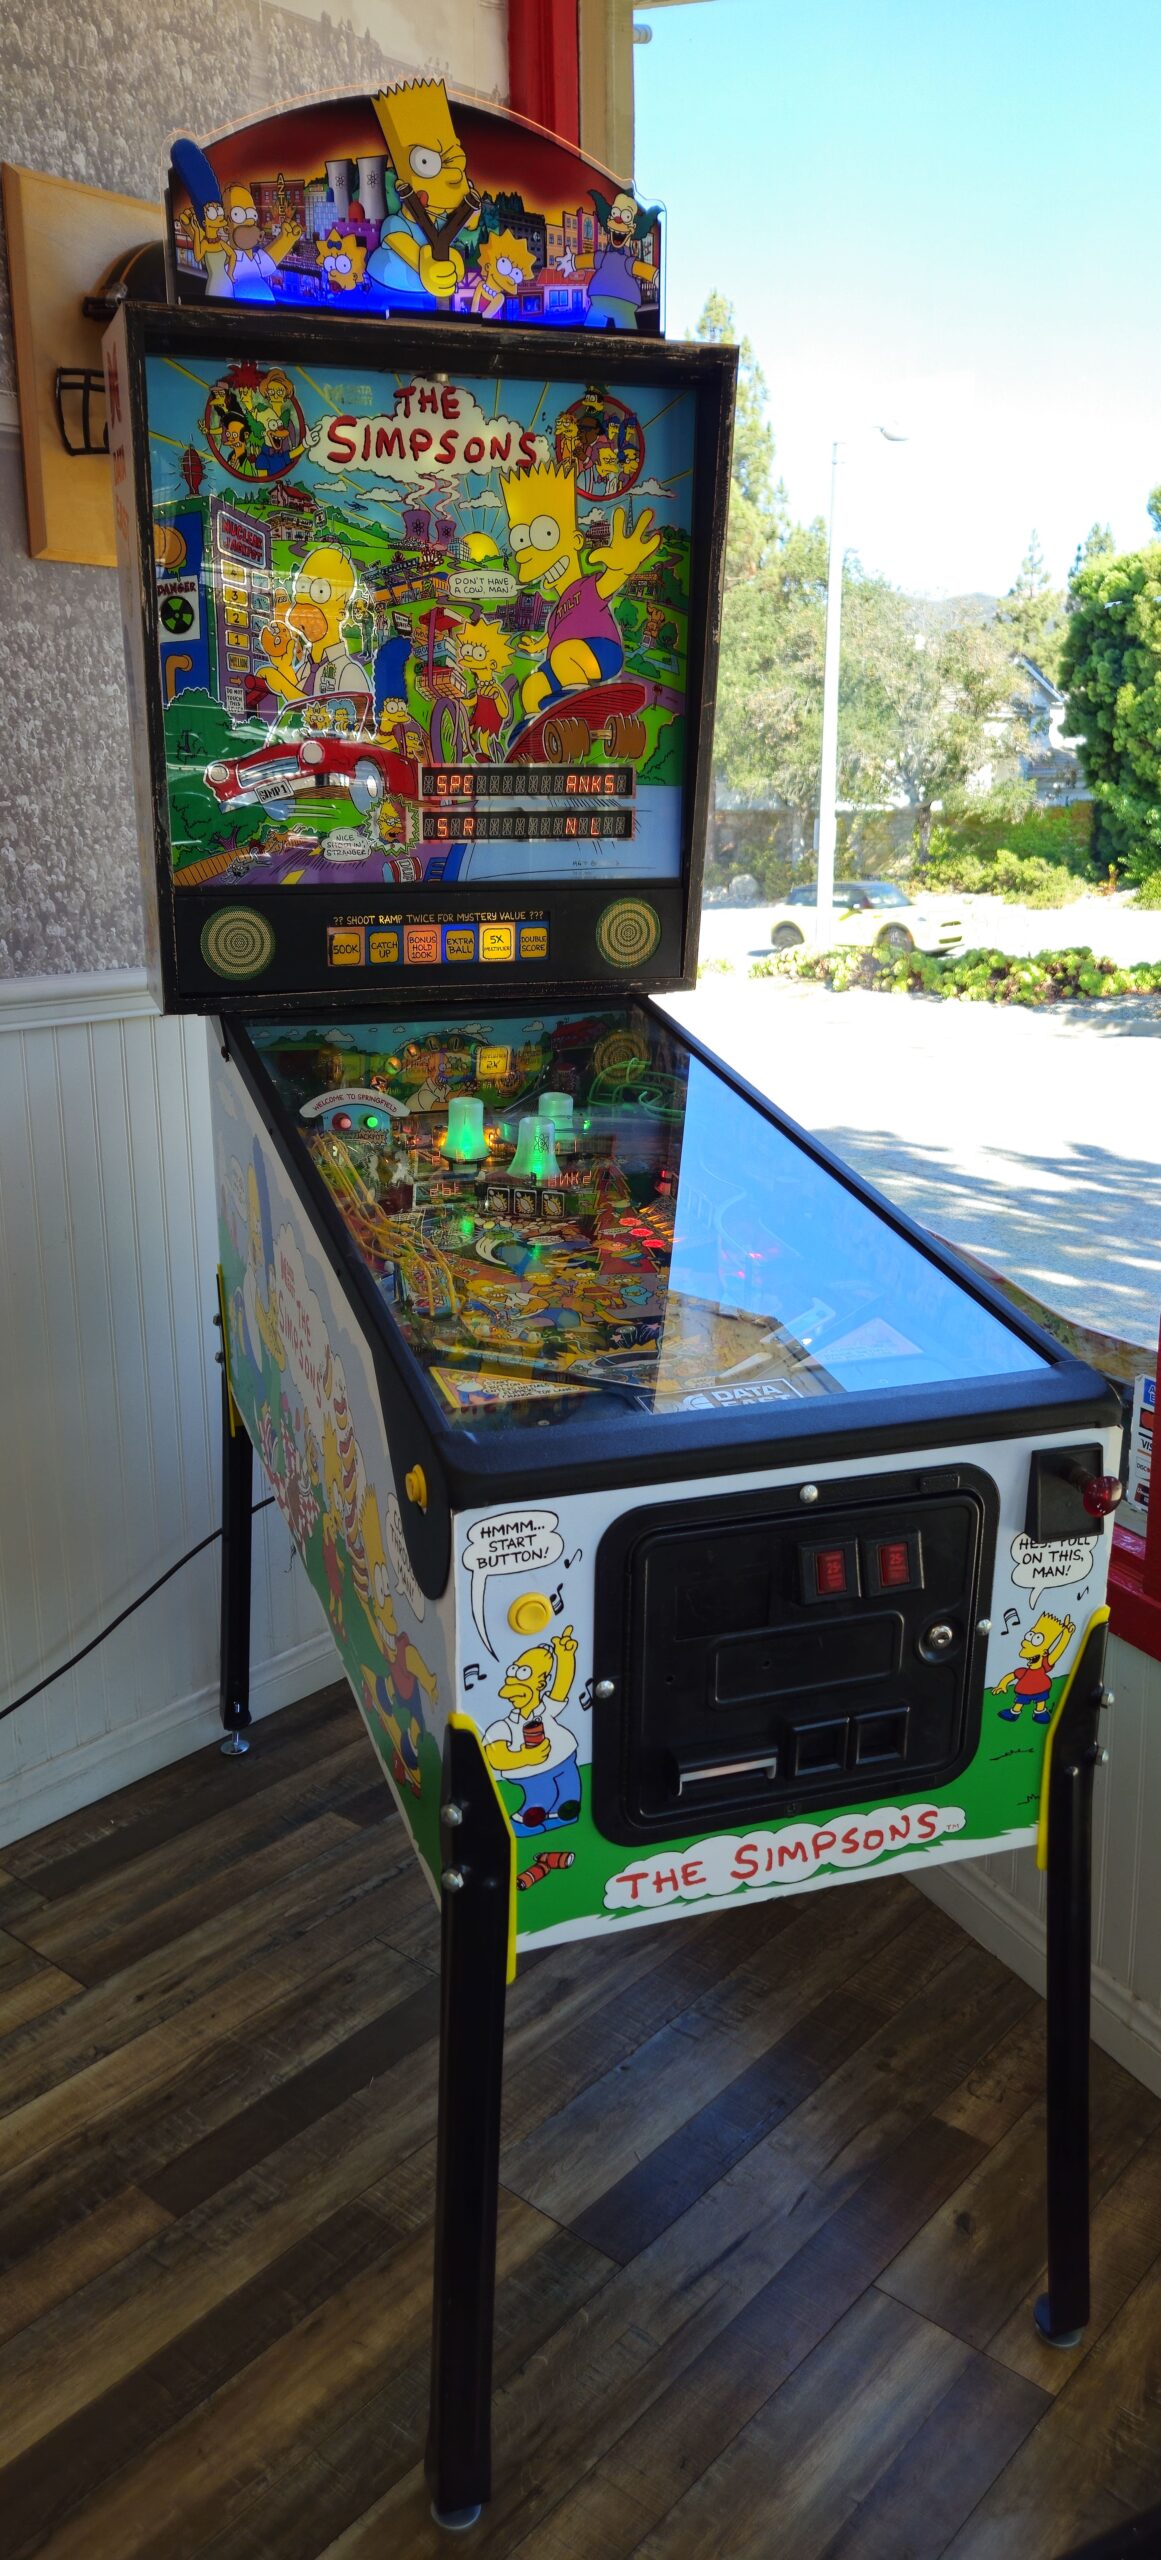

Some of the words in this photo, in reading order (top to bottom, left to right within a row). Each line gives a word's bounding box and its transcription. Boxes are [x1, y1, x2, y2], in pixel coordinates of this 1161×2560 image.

[393, 385, 461, 420] THE
[327, 415, 536, 468] SIMPSONS
[156, 581, 197, 596] DANGER
[488, 585, 514, 593] MAN!
[232, 591, 239, 600] 3
[556, 592, 581, 618] TILT
[232, 613, 240, 624] 2
[234, 635, 241, 645] 1
[437, 775, 474, 794] SPE
[566, 775, 615, 793] ANKS
[333, 916, 343, 925] ??
[347, 916, 375, 925] SHOOT
[378, 914, 403, 924] RAMP
[406, 914, 435, 923] TWICE
[437, 913, 454, 922] FOR
[456, 912, 497, 922] MYSTERY
[500, 911, 526, 921] VALUE
[529, 911, 544, 920] ???
[409, 936, 437, 944] BONUS
[447, 937, 474, 945] EXTRA
[490, 935, 504, 944] 5X
[521, 935, 546, 943] DOUBLE
[333, 944, 360, 955] 500K
[371, 941, 398, 950] CATCH
[449, 945, 472, 954] BALL
[522, 943, 545, 951] SCORE
[379, 950, 391, 959] UP
[411, 951, 432, 959] 100K
[313, 1093, 344, 1111] WELCOME
[358, 1093, 398, 1113] SPRINGFIELD
[355, 1132, 386, 1140] JACKPOT
[279, 1289, 322, 1409] SIMPSONS
[712, 1384, 783, 1401] DATA
[1140, 1438, 1152, 1451] VIS
[480, 1520, 545, 1539] HMMM...
[489, 1534, 537, 1552] START
[1019, 1538, 1051, 1550] HE
[476, 1546, 549, 1568] BUTTON!
[1022, 1552, 1042, 1565] ON
[1048, 1549, 1084, 1563] THIS,
[1032, 1565, 1071, 1579] MAN!
[616, 1860, 707, 1899] THE
[730, 1810, 938, 1880] SIMPSONS
